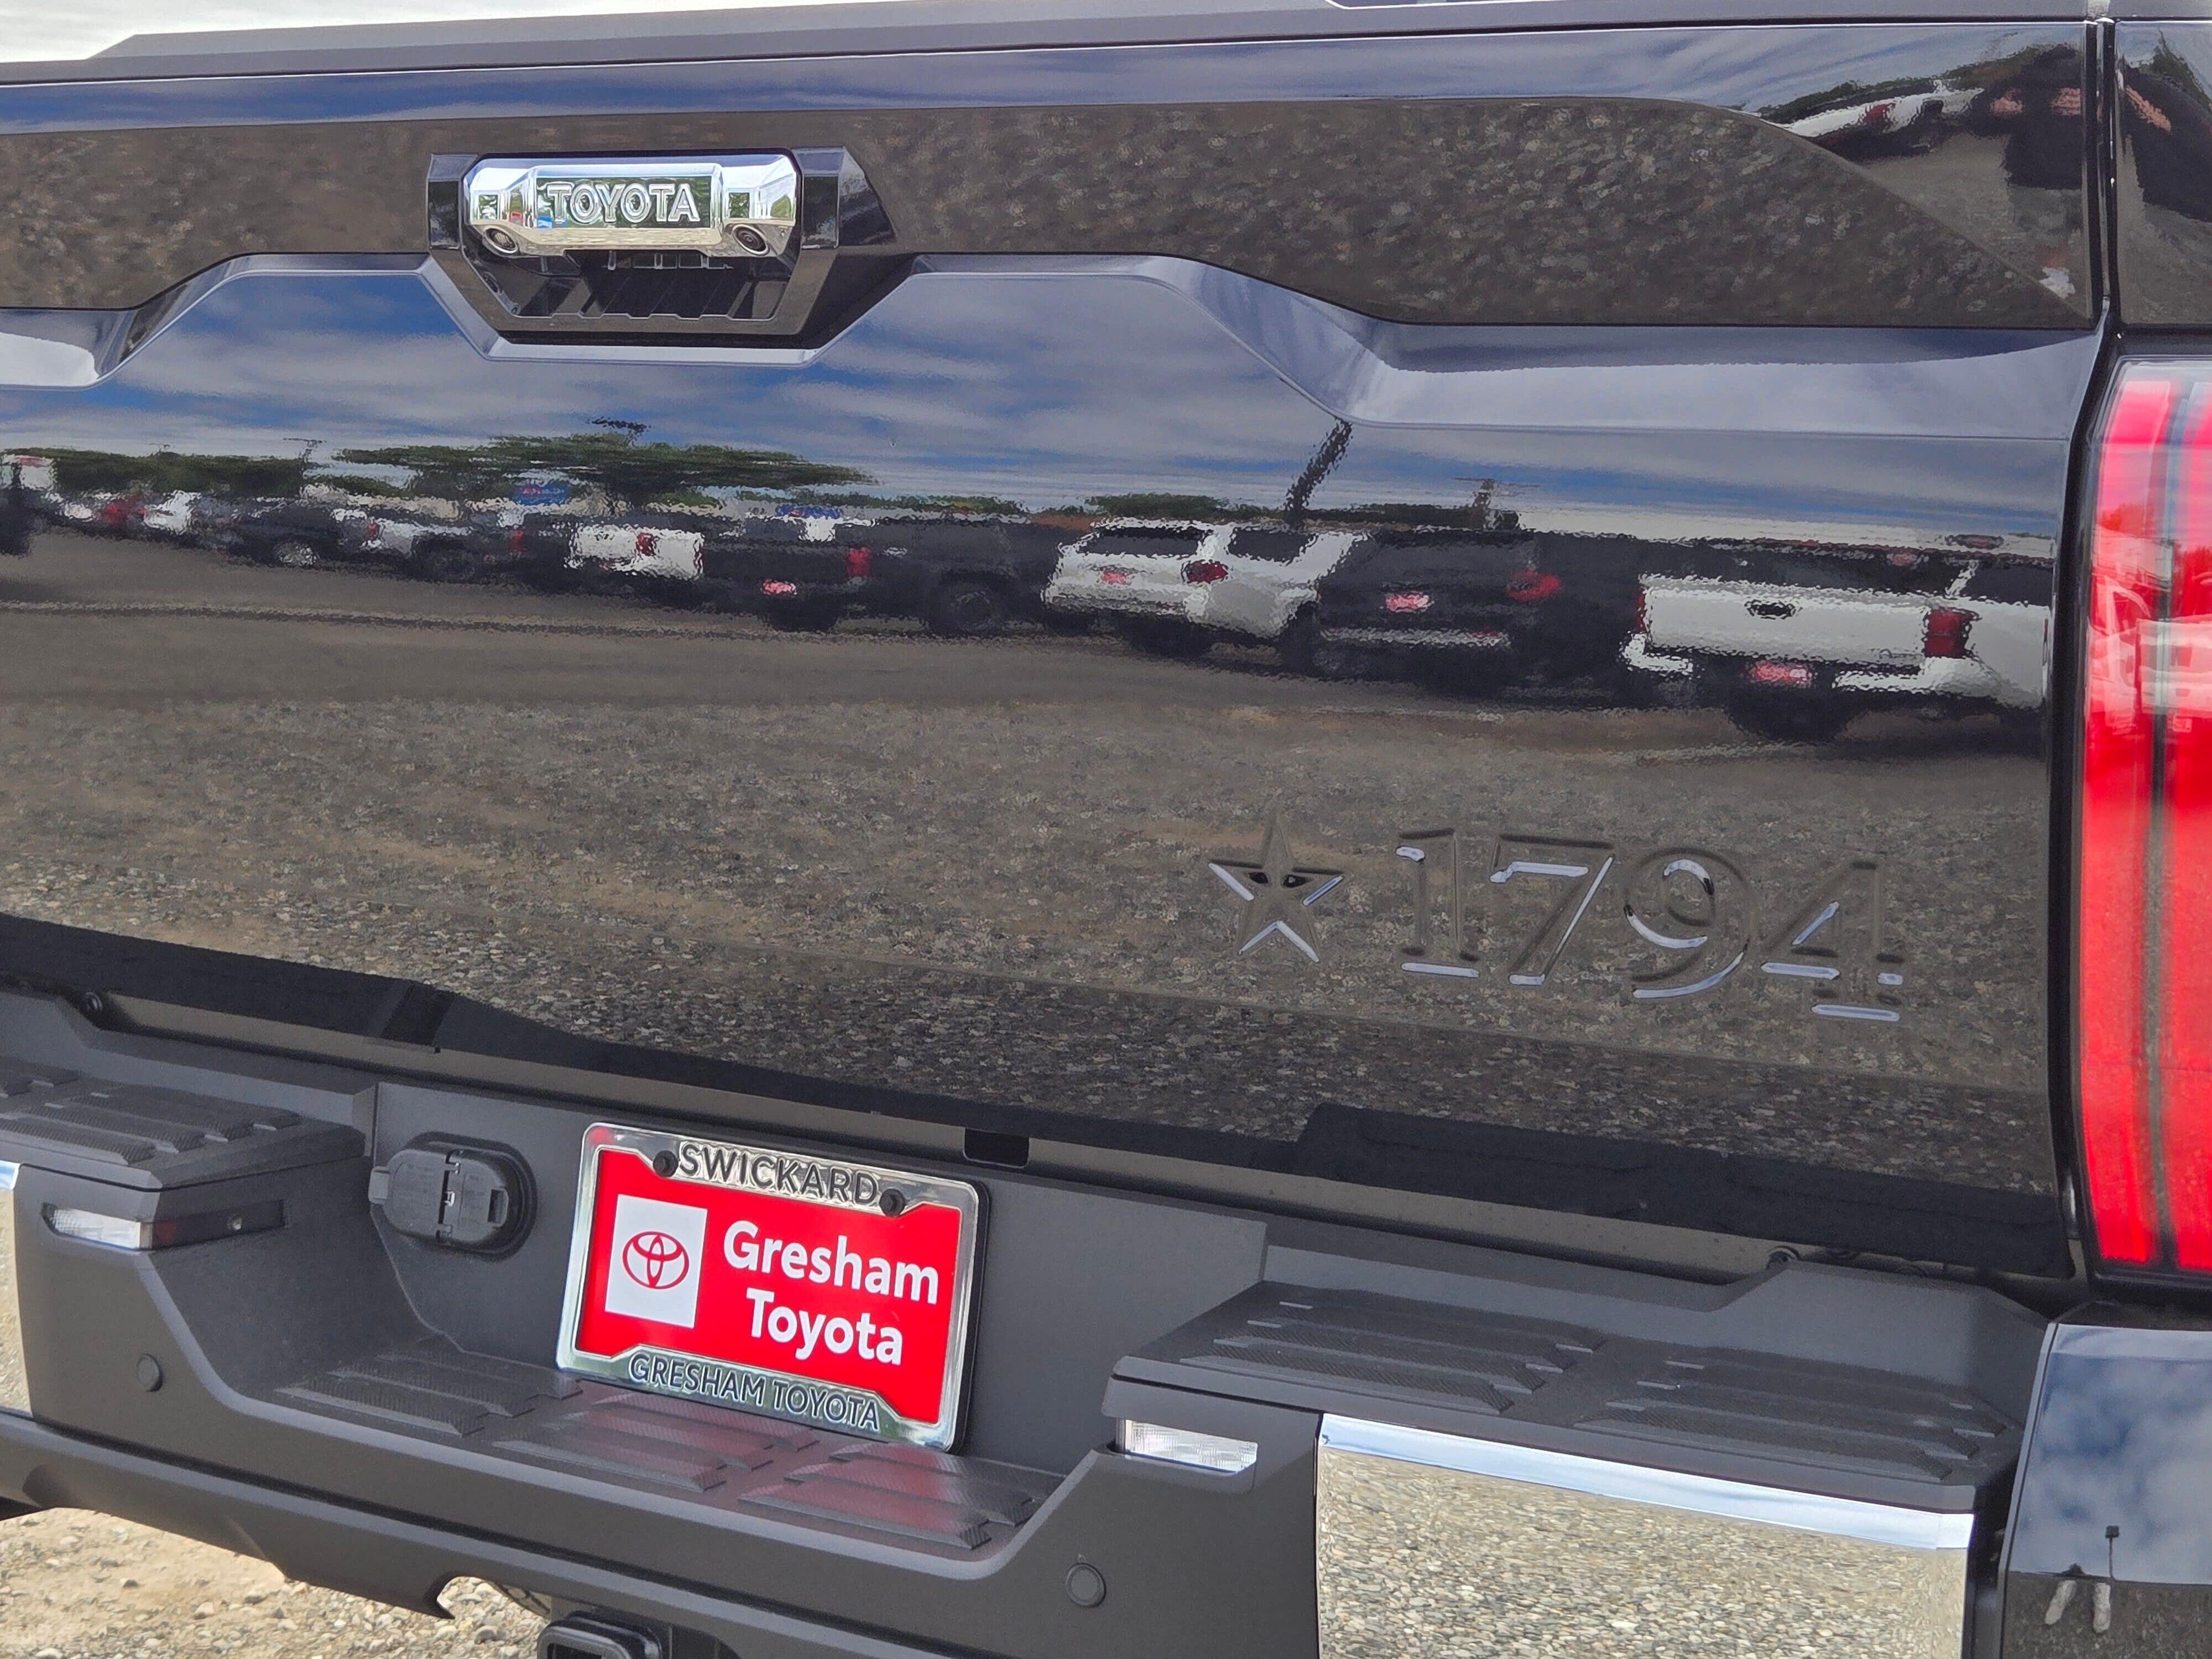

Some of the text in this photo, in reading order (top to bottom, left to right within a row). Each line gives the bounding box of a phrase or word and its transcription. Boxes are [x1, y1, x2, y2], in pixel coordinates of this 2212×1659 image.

[546, 181, 701, 223] TOYOTA
[1396, 827, 1904, 1021] 1794
[679, 1144, 878, 1206] SWICKARD
[723, 1220, 938, 1305] Gresham
[745, 1288, 904, 1366] Toyota
[628, 1354, 880, 1431] GRESHAM TOYOTA
